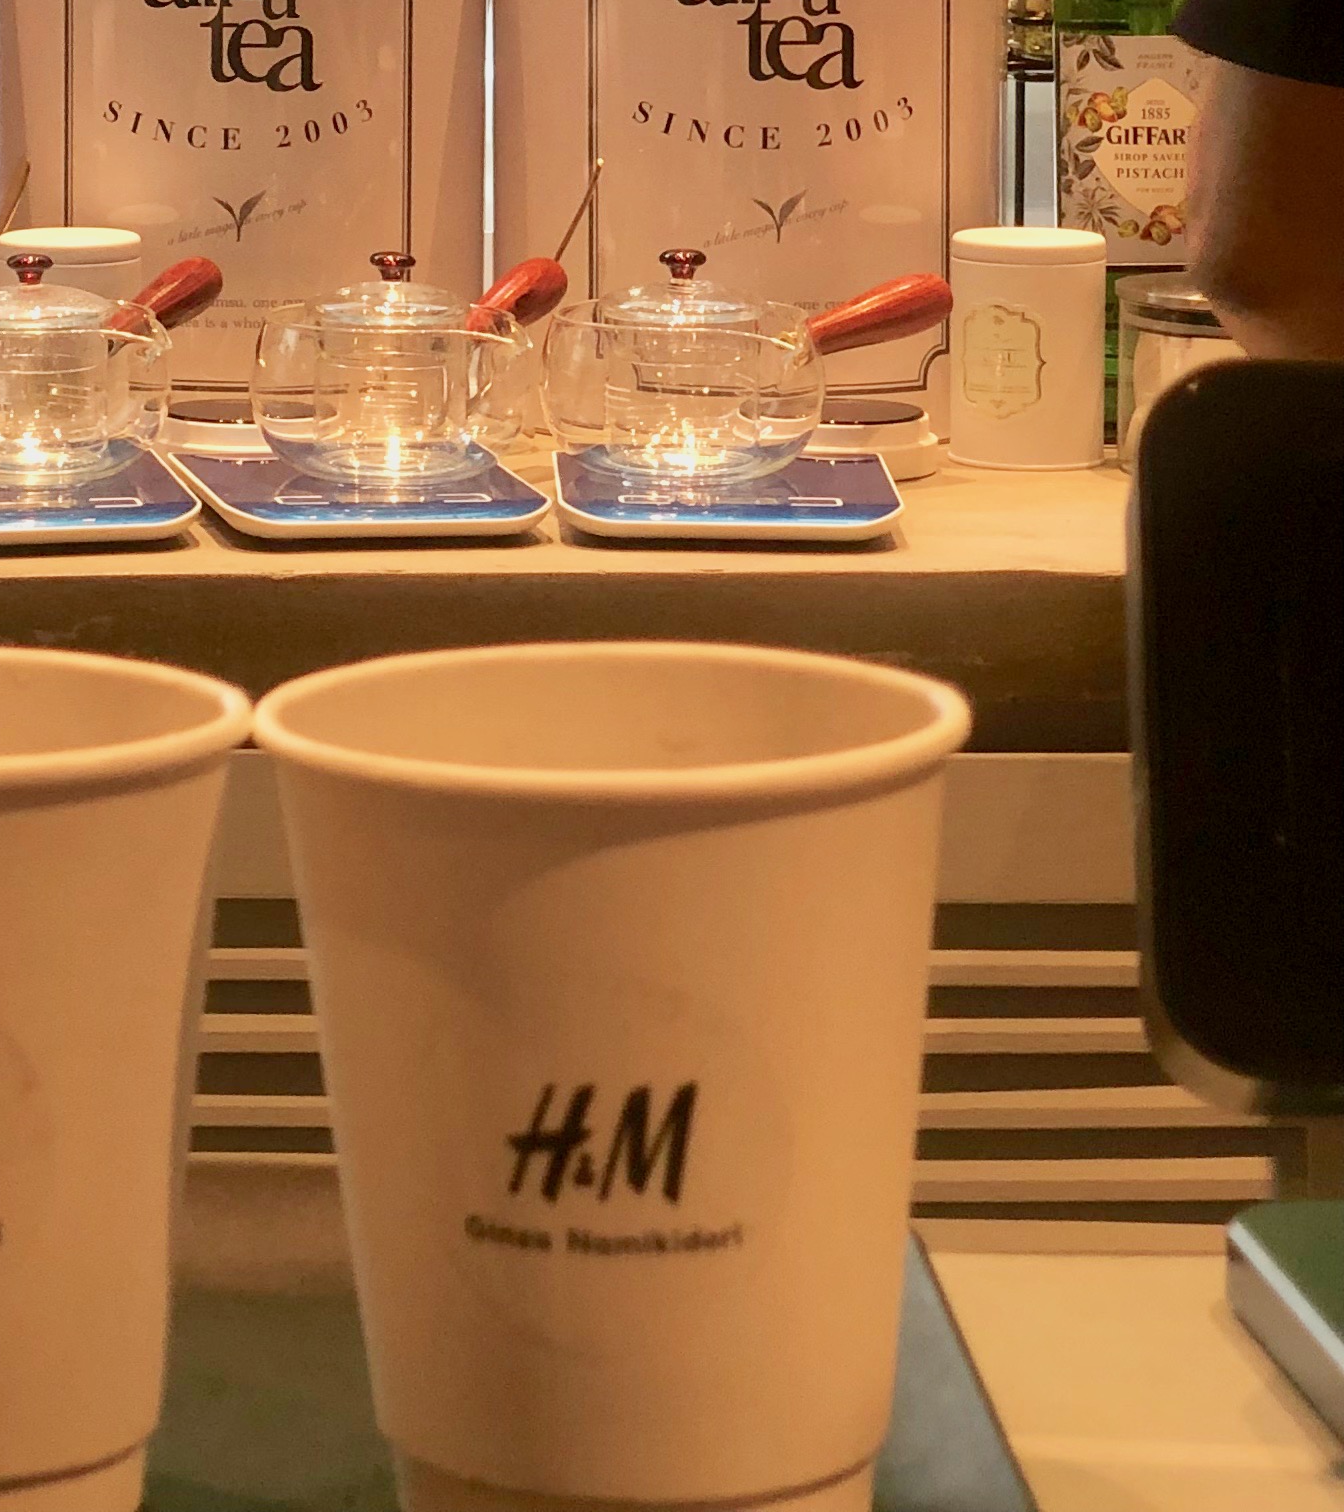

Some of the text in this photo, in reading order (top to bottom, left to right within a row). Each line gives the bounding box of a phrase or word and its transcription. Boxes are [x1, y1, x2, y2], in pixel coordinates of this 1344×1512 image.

[200, 7, 323, 92] tea
[737, 1, 864, 90] tea
[1137, 61, 1174, 69] FRANCE
[1141, 107, 1171, 120] 1885
[103, 98, 374, 150] SINCE 2003
[631, 95, 915, 150] SINCE 2003
[1106, 125, 1189, 145] GIFFAR
[1114, 153, 1148, 161] SIROP
[1116, 167, 1185, 178] PISTACH
[253, 299, 278, 308] one
[206, 317, 216, 328] is
[220, 320, 228, 329] a
[233, 317, 267, 328] whol
[505, 1080, 698, 1205] H&M
